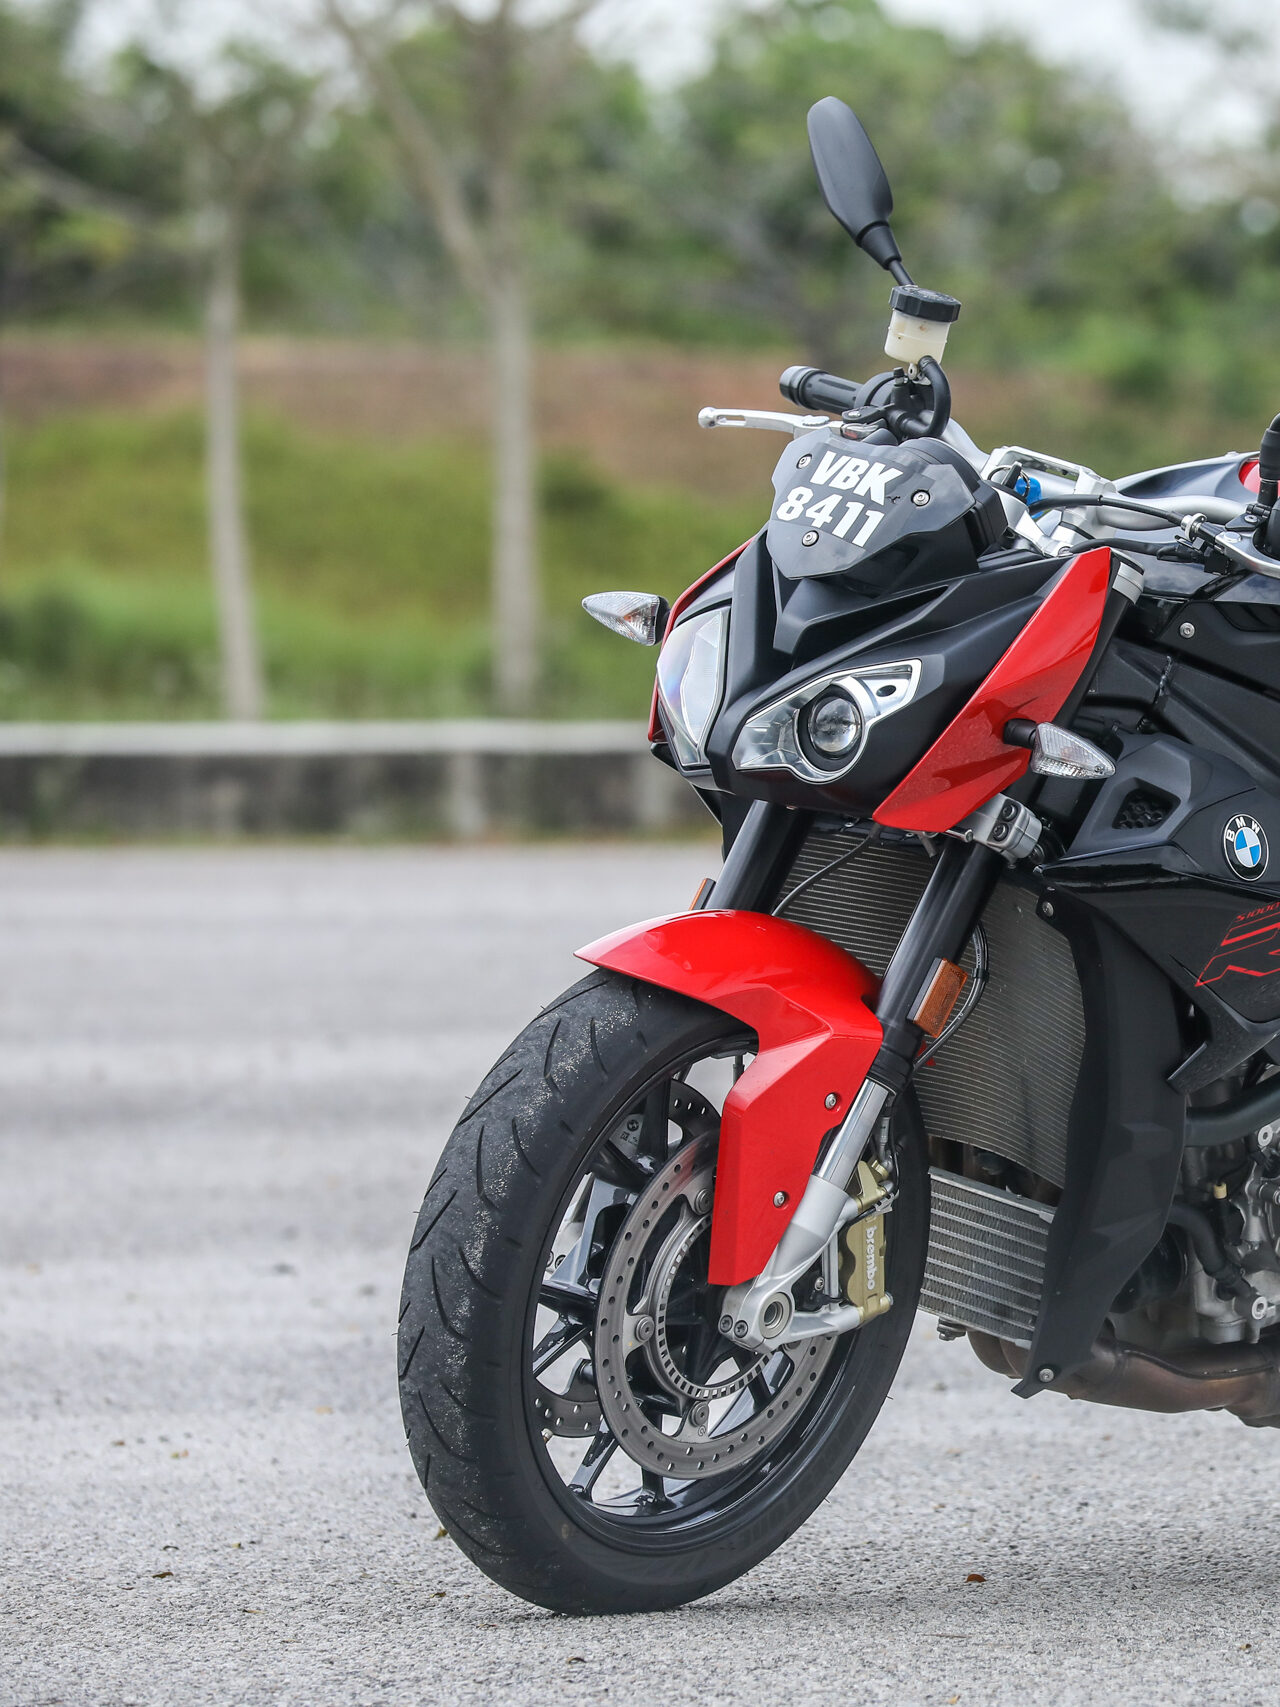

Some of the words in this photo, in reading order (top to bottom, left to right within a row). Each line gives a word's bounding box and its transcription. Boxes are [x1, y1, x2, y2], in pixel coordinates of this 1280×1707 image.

[810, 450, 903, 506] VBK
[776, 486, 885, 547] 8411
[1226, 816, 1261, 842] BMW
[866, 1225, 878, 1291] brembo
